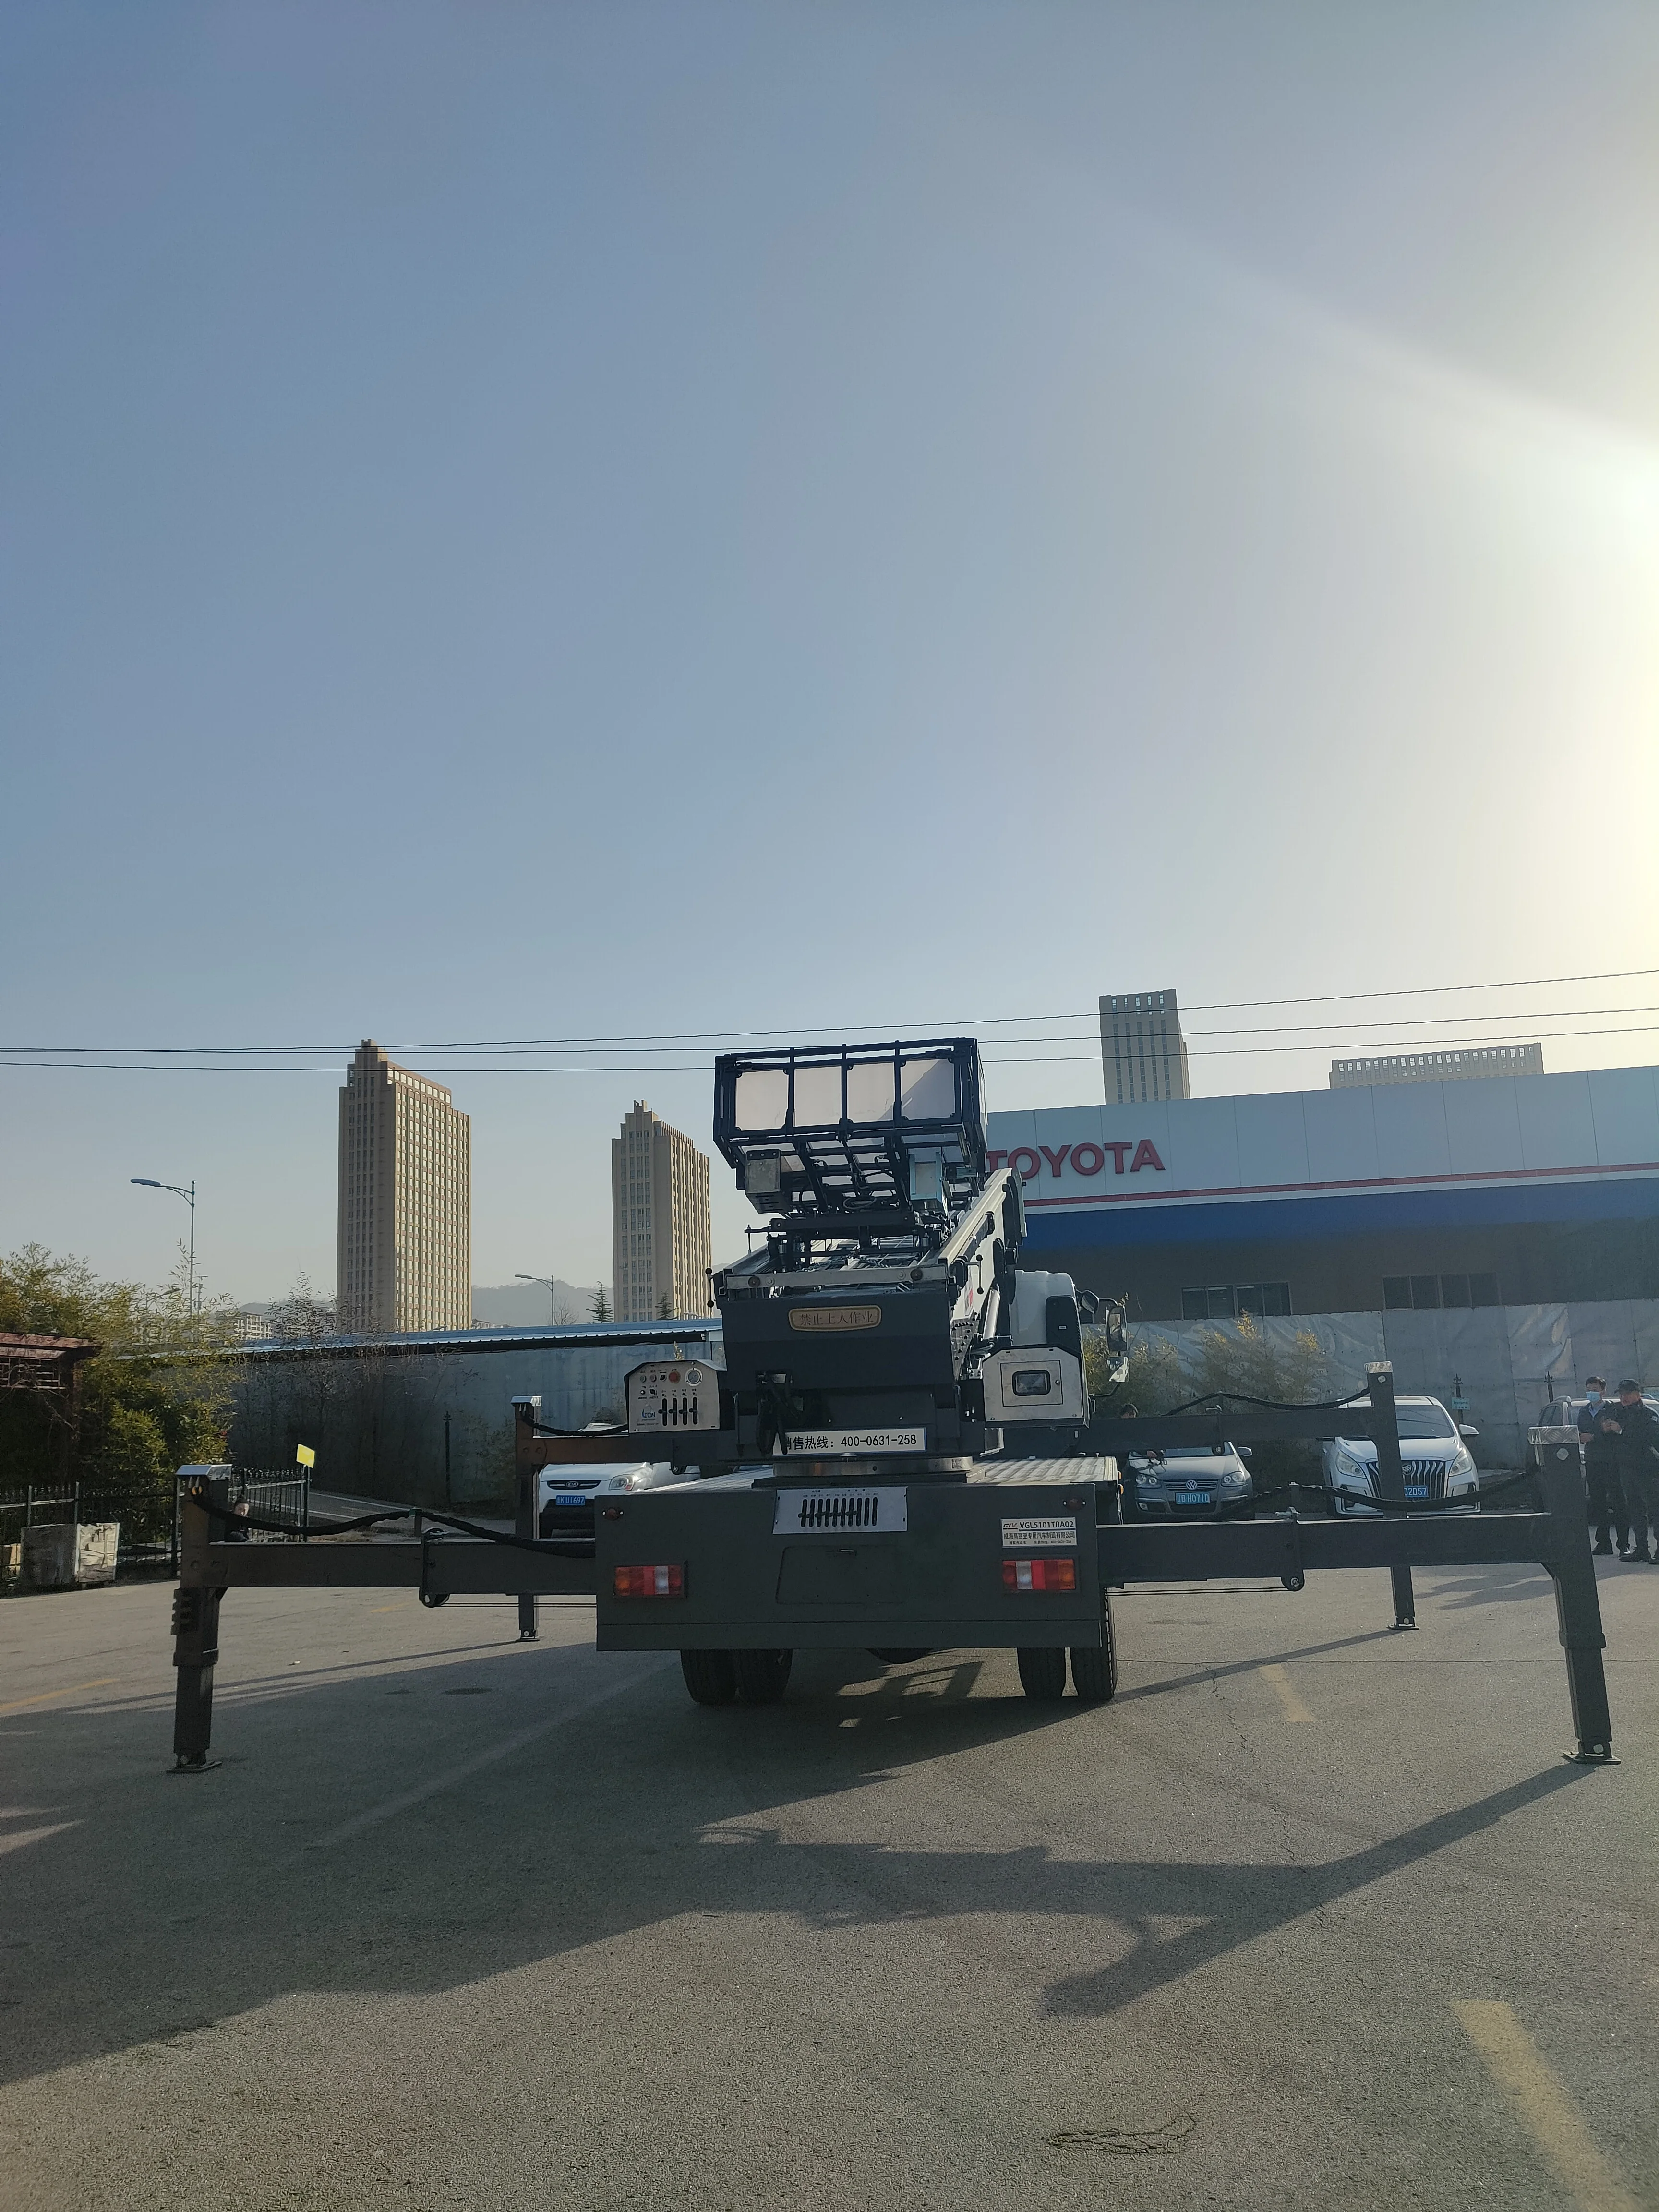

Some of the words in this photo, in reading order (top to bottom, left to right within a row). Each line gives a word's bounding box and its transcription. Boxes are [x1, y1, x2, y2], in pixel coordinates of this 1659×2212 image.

[986, 1138, 1166, 1180] TOYOTA
[799, 1311, 874, 1326] 禁止上人作业
[840, 1434, 917, 1447] 400-0631-258
